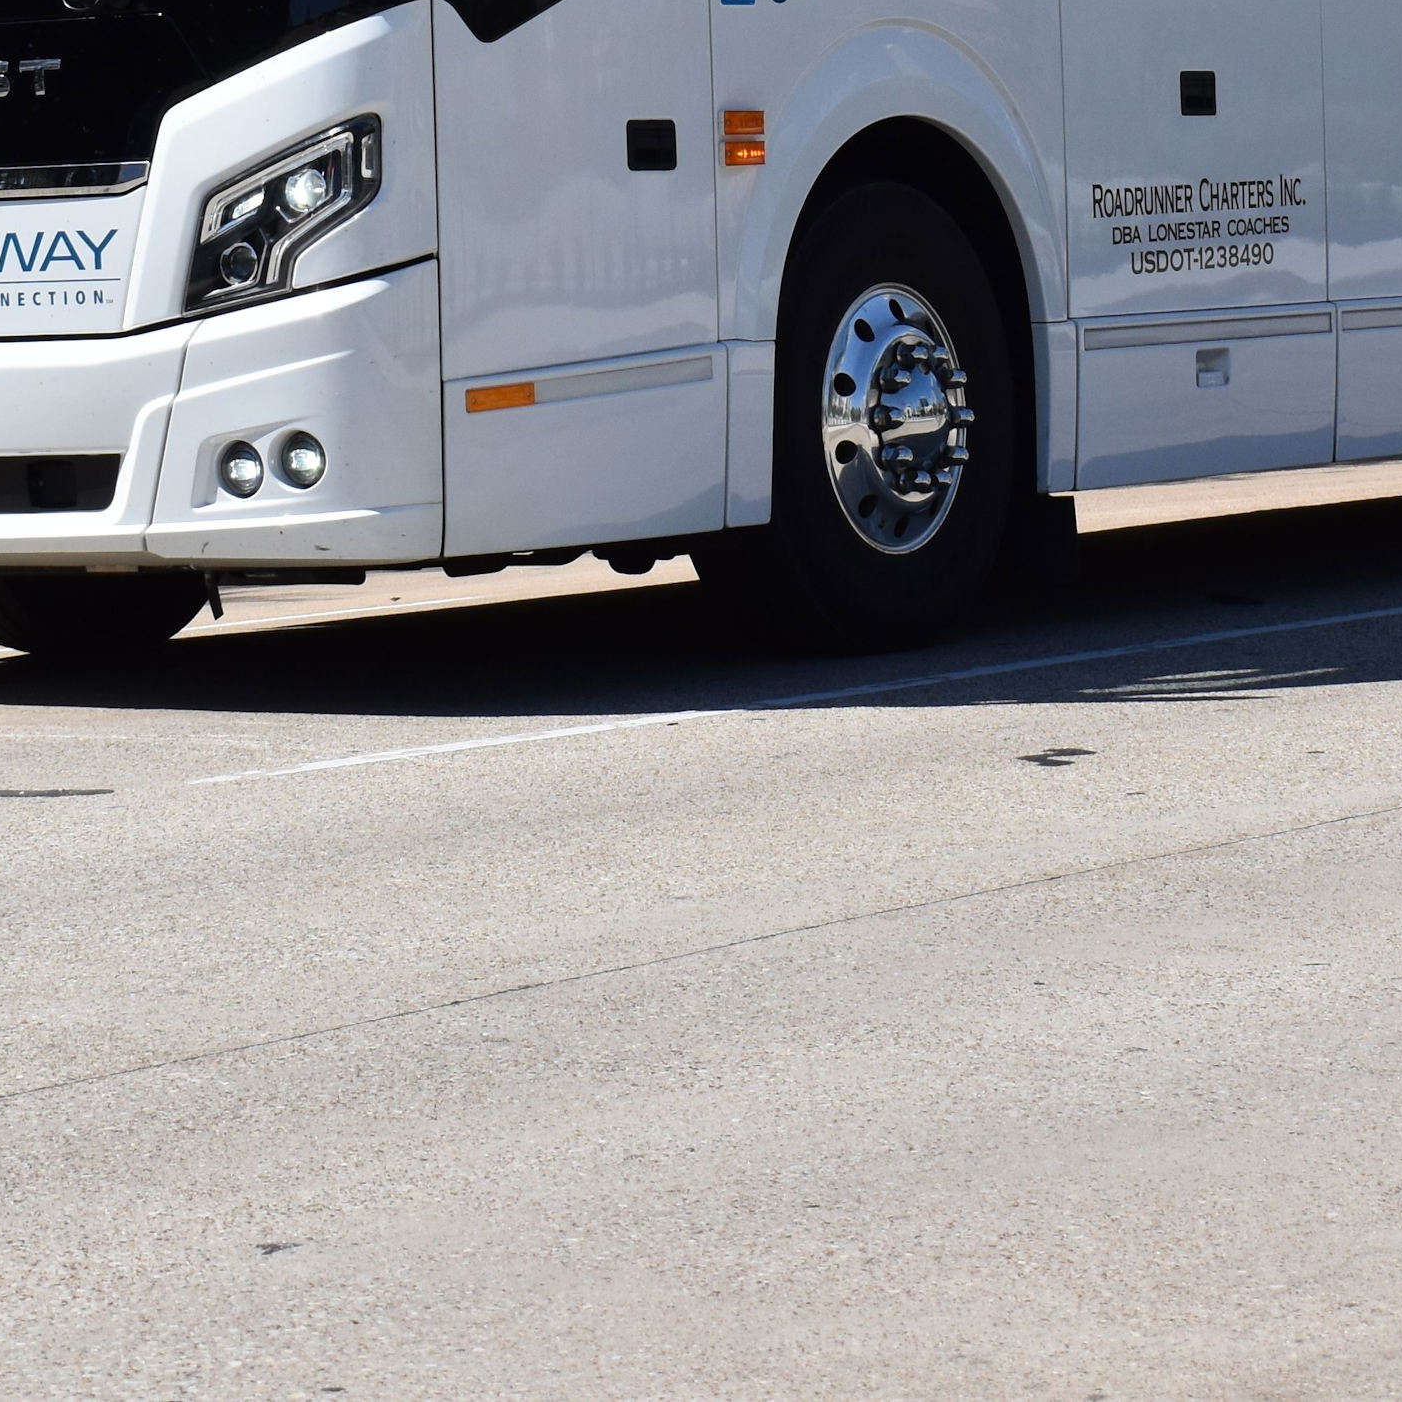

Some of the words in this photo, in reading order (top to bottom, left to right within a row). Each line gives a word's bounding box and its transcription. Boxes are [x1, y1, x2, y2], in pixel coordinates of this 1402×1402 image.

[1091, 182, 1194, 219] ROADRUNNER
[1198, 177, 1274, 213] CHARTERS
[1111, 225, 1142, 245] DBA
[1148, 220, 1221, 244] LONESTAR
[1227, 215, 1290, 236] COACHES
[1130, 241, 1275, 275] USDOT-1238490
